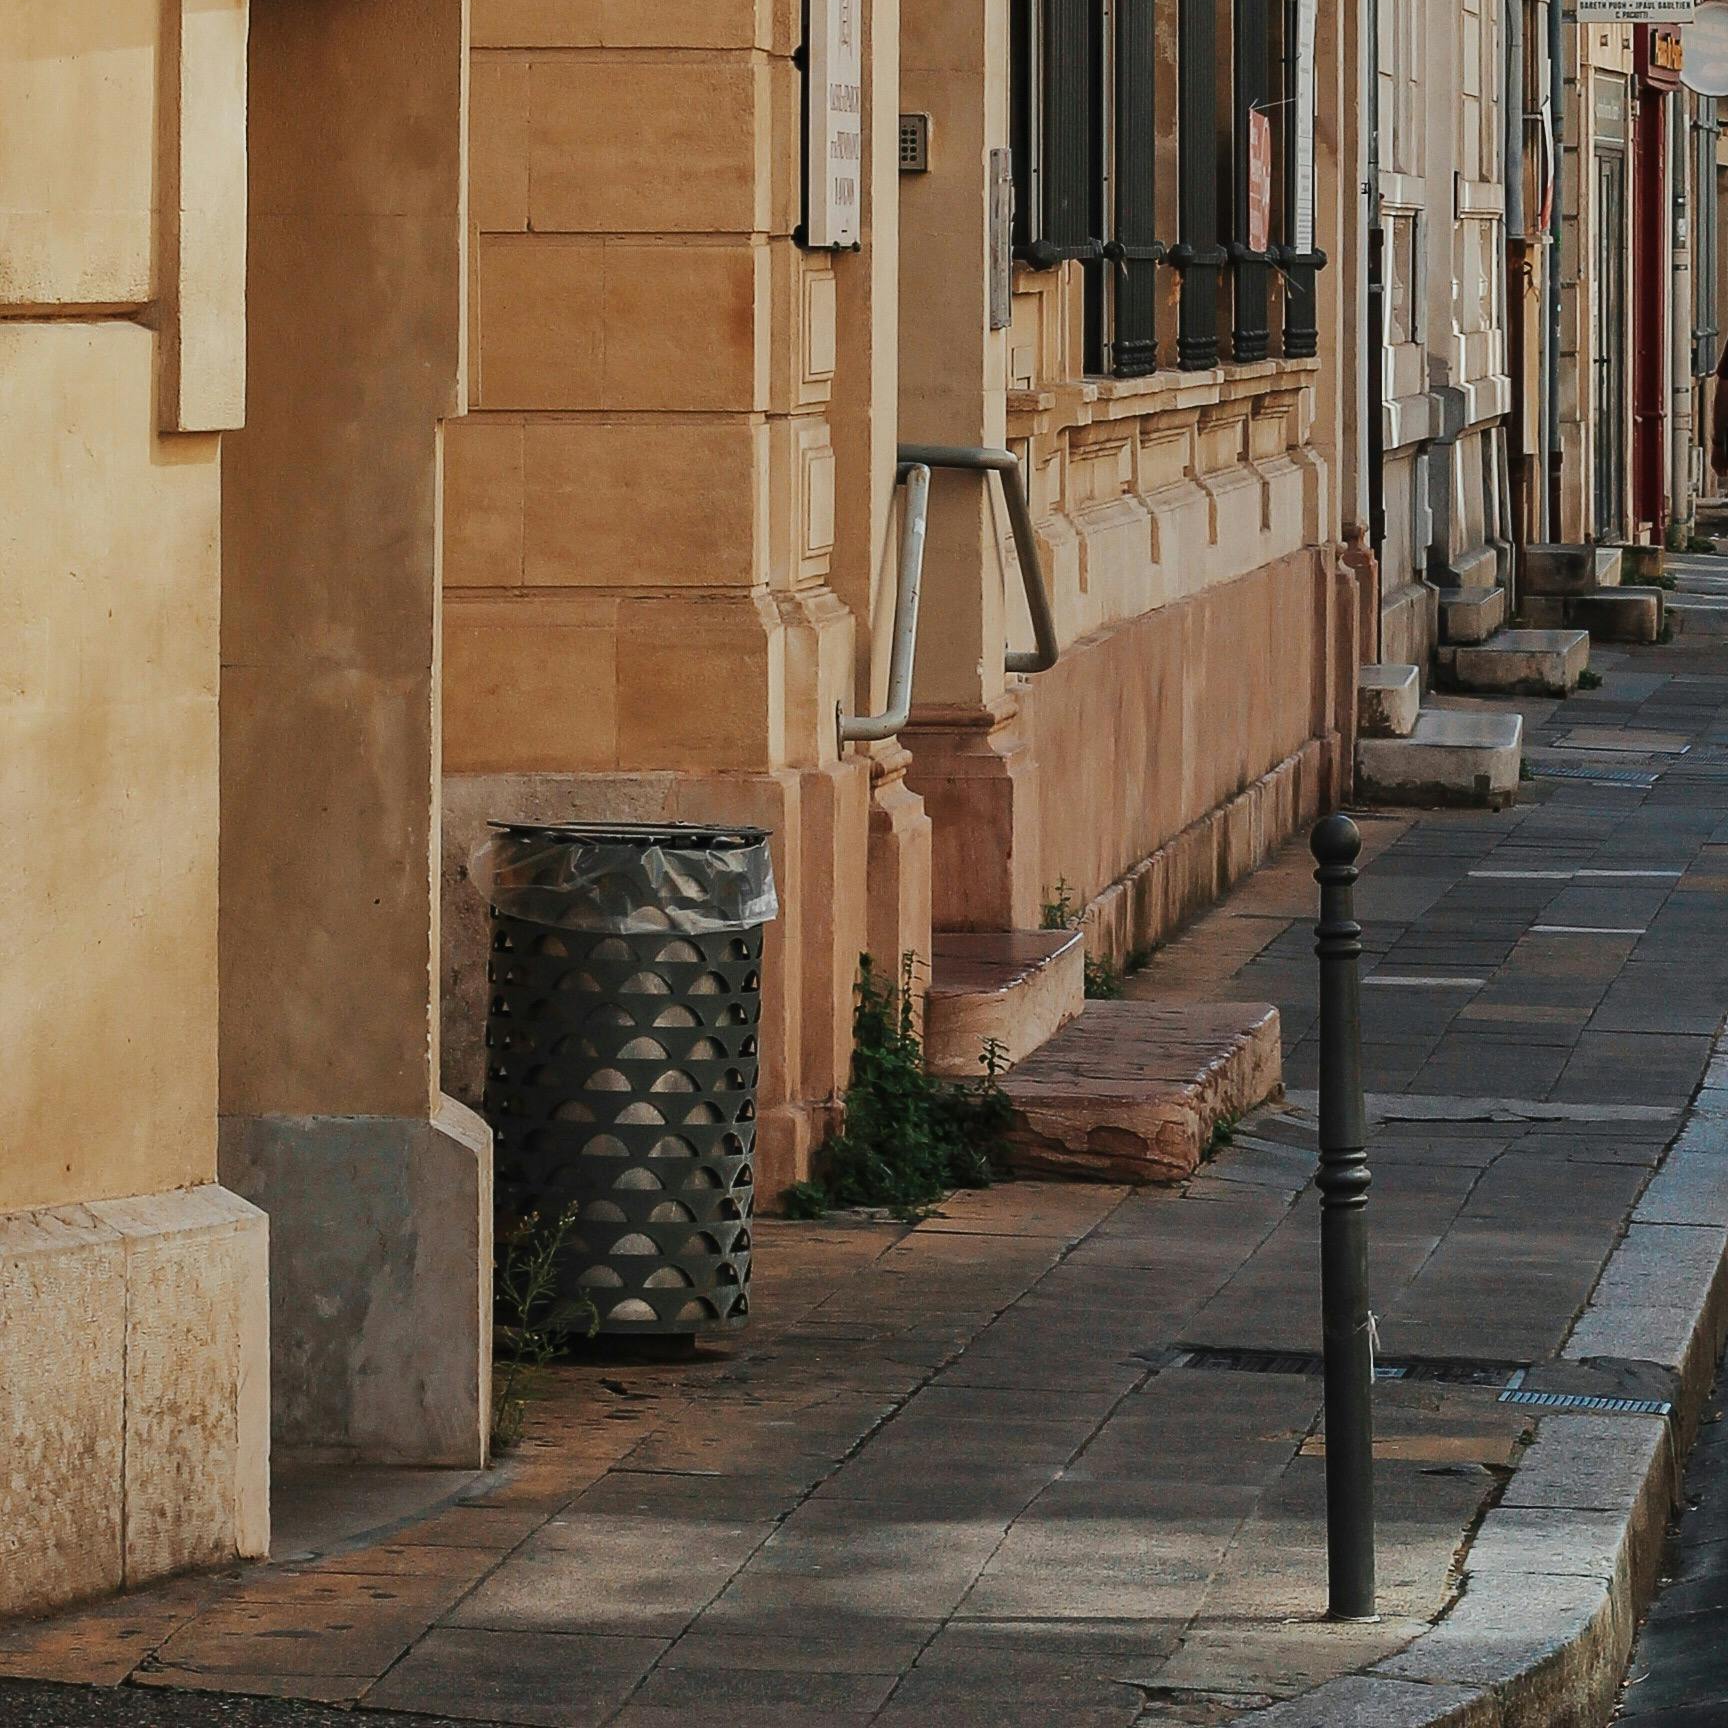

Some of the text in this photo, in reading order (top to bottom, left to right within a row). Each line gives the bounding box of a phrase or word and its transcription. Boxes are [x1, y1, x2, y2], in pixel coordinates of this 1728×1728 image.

[1580, 2, 1607, 10] GARETH
[1608, 2, 1627, 10] PUGH
[1658, 2, 1691, 10] GAULTIER
